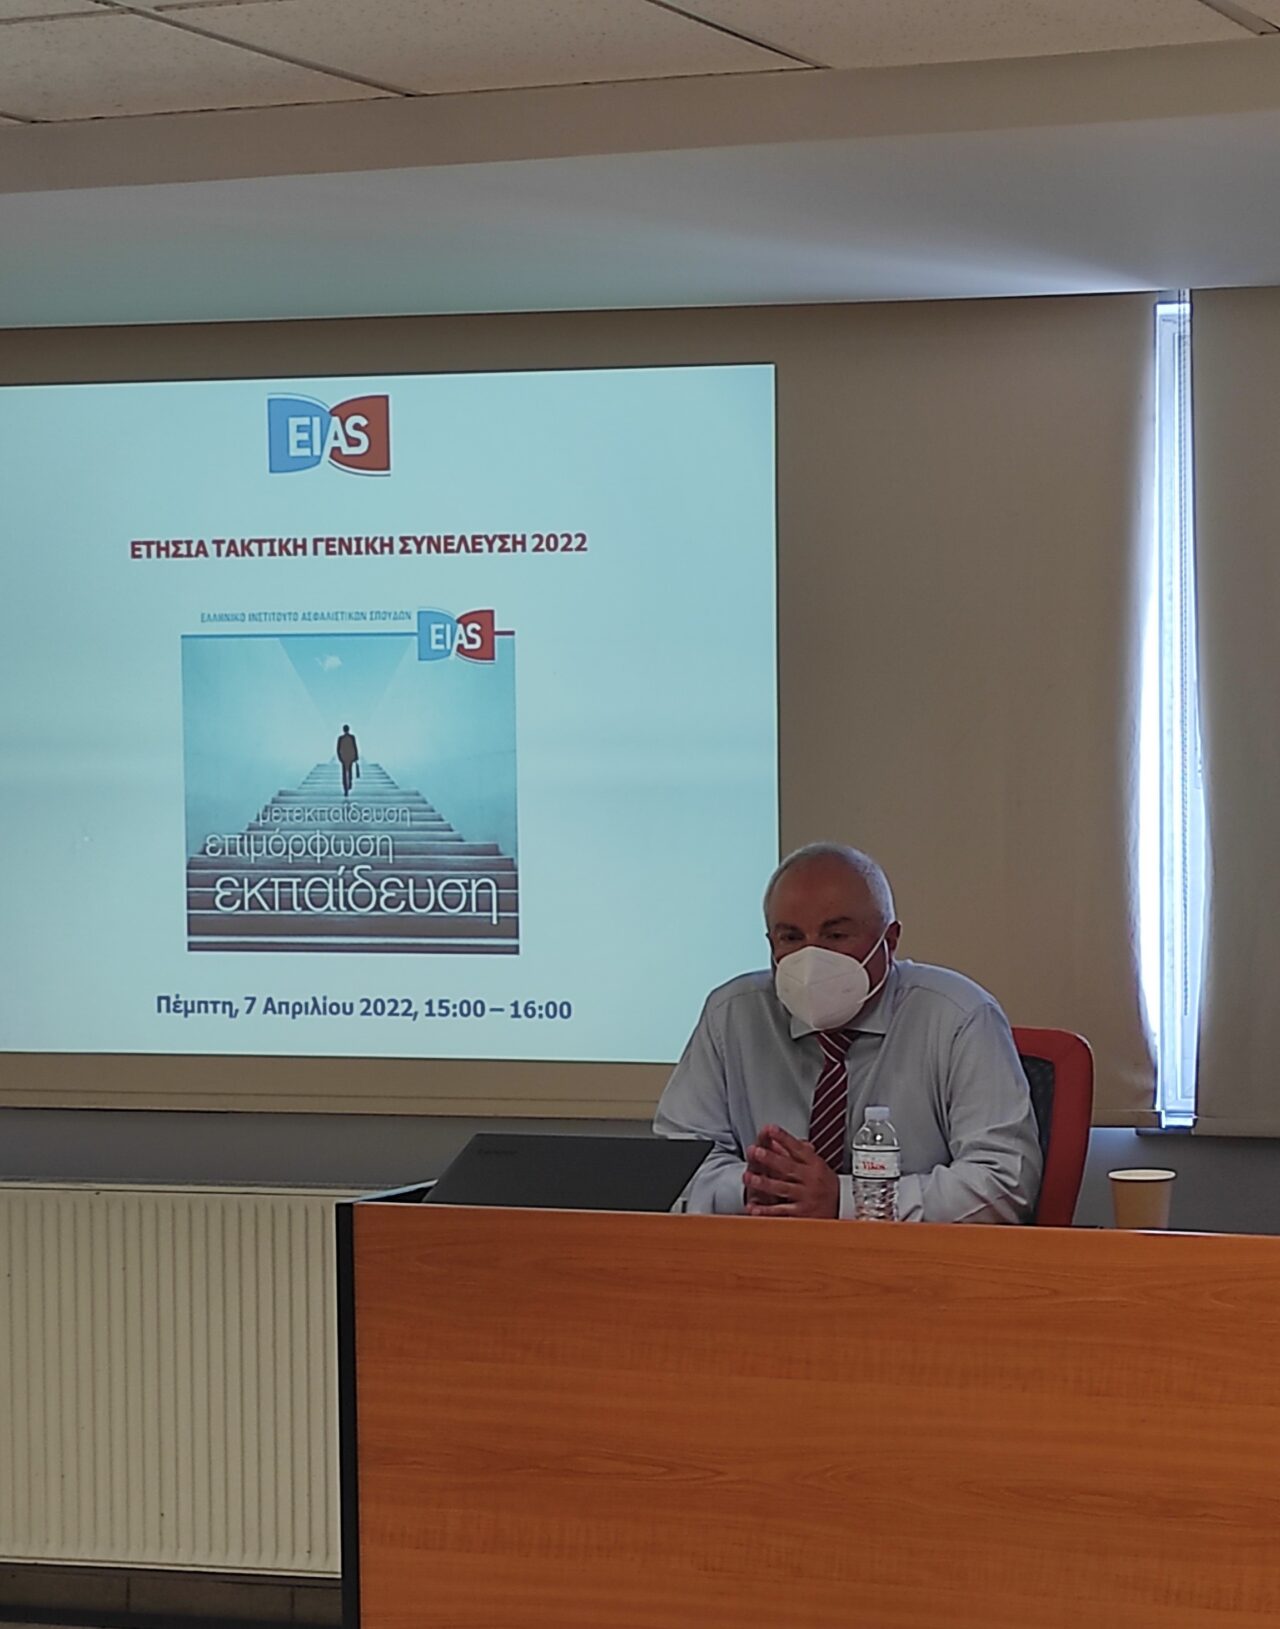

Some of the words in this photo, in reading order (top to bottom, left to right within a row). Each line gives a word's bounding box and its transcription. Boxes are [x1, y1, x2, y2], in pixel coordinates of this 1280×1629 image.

[287, 414, 370, 460] EIAS
[130, 540, 209, 559] ΕΤΗΣΙΑ
[212, 538, 307, 557] ΤΑΚΤΙΚΗ
[312, 536, 394, 556] ΓΕΝΙΚΗ
[399, 534, 526, 555] ΣΥΝΕΛΕΥΣΗ
[531, 533, 588, 552] 2022
[430, 622, 482, 653] EIAS
[258, 802, 412, 826] μετεκπαίδευση
[204, 828, 394, 864] επιμόρφωση
[213, 864, 499, 926] εκπαίδευση
[156, 994, 239, 1018] Πέμπτη,
[244, 996, 257, 1015] 7
[262, 995, 354, 1020] Απριλίου
[359, 998, 418, 1021] 2022,
[424, 999, 486, 1018] 15:00
[509, 1000, 573, 1019] 16:00
